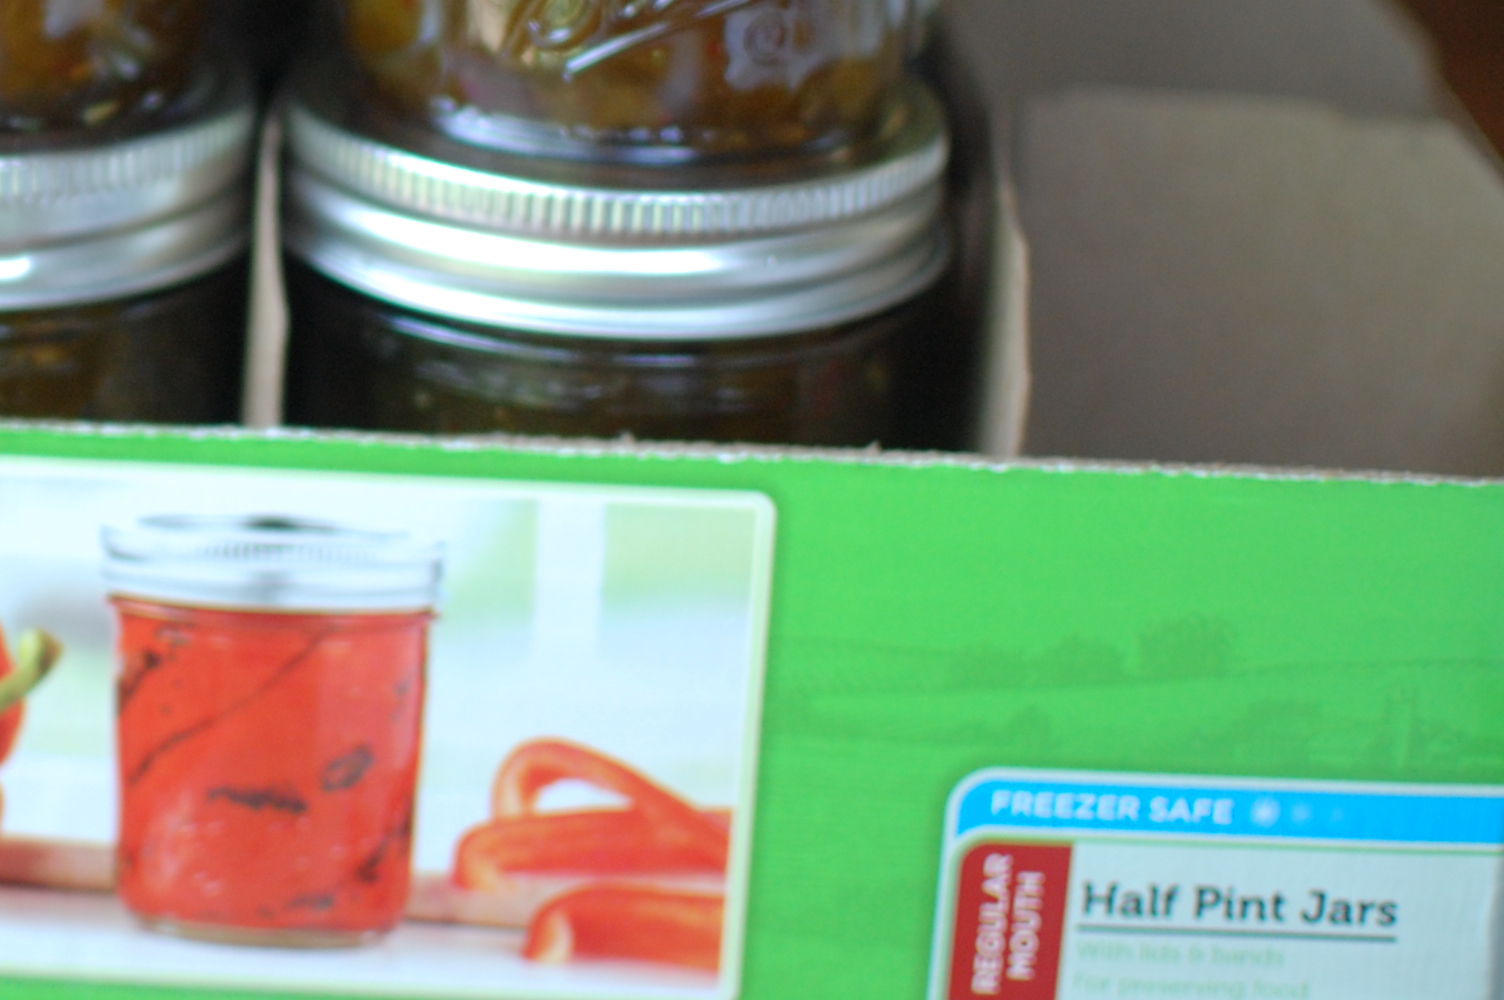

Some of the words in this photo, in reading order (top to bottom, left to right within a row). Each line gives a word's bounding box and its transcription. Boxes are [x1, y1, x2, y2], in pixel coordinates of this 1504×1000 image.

[990, 789, 1141, 821] FREEZER
[1147, 795, 1236, 826] SAFE
[970, 852, 1014, 995] REGULAR
[1006, 871, 1046, 981] MOUTH
[1082, 880, 1180, 918] Half
[1193, 884, 1286, 922] Pint
[1298, 889, 1399, 927] Jars
